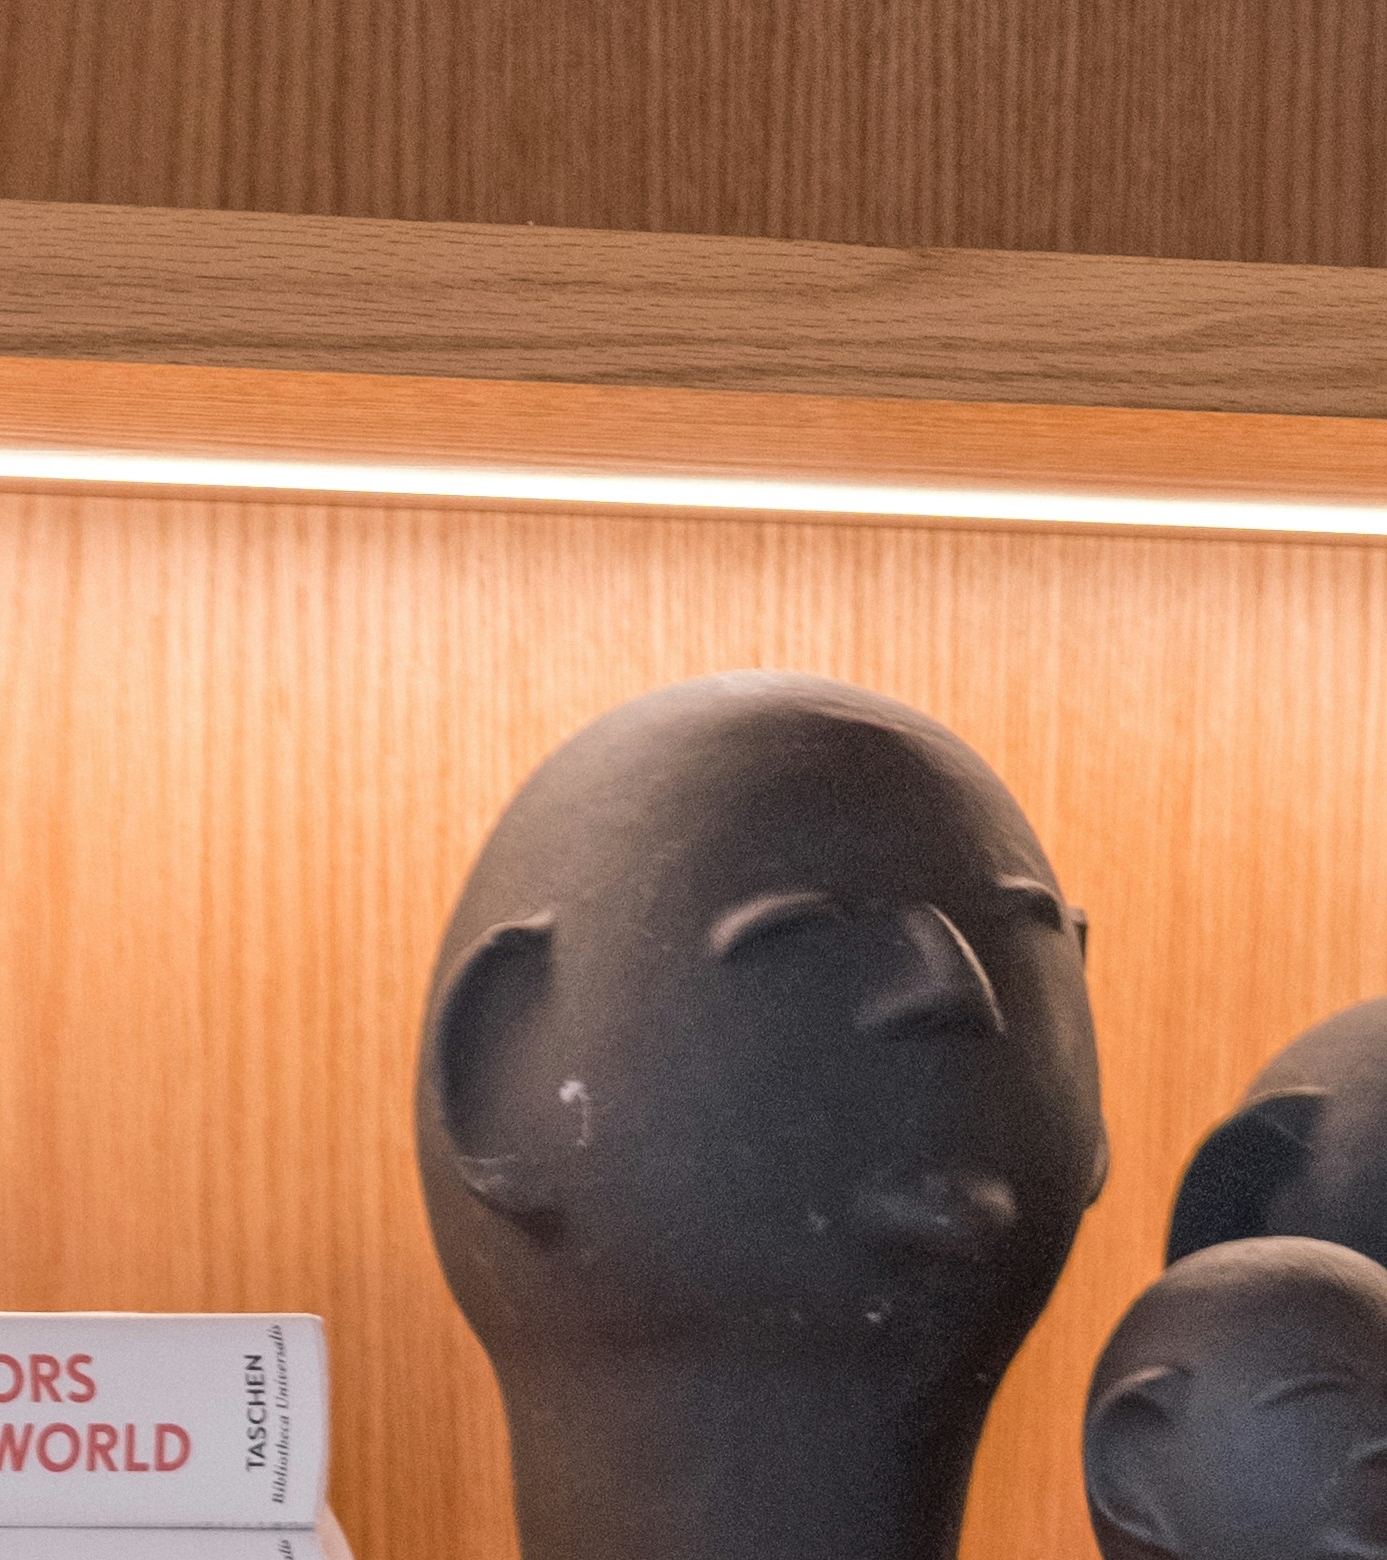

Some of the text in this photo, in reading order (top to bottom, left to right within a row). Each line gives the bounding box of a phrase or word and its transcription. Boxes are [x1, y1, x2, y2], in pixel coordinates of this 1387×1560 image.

[244, 1354, 268, 1472] TASCHEN
[269, 1323, 290, 1504] Bibliotheca Universalis
